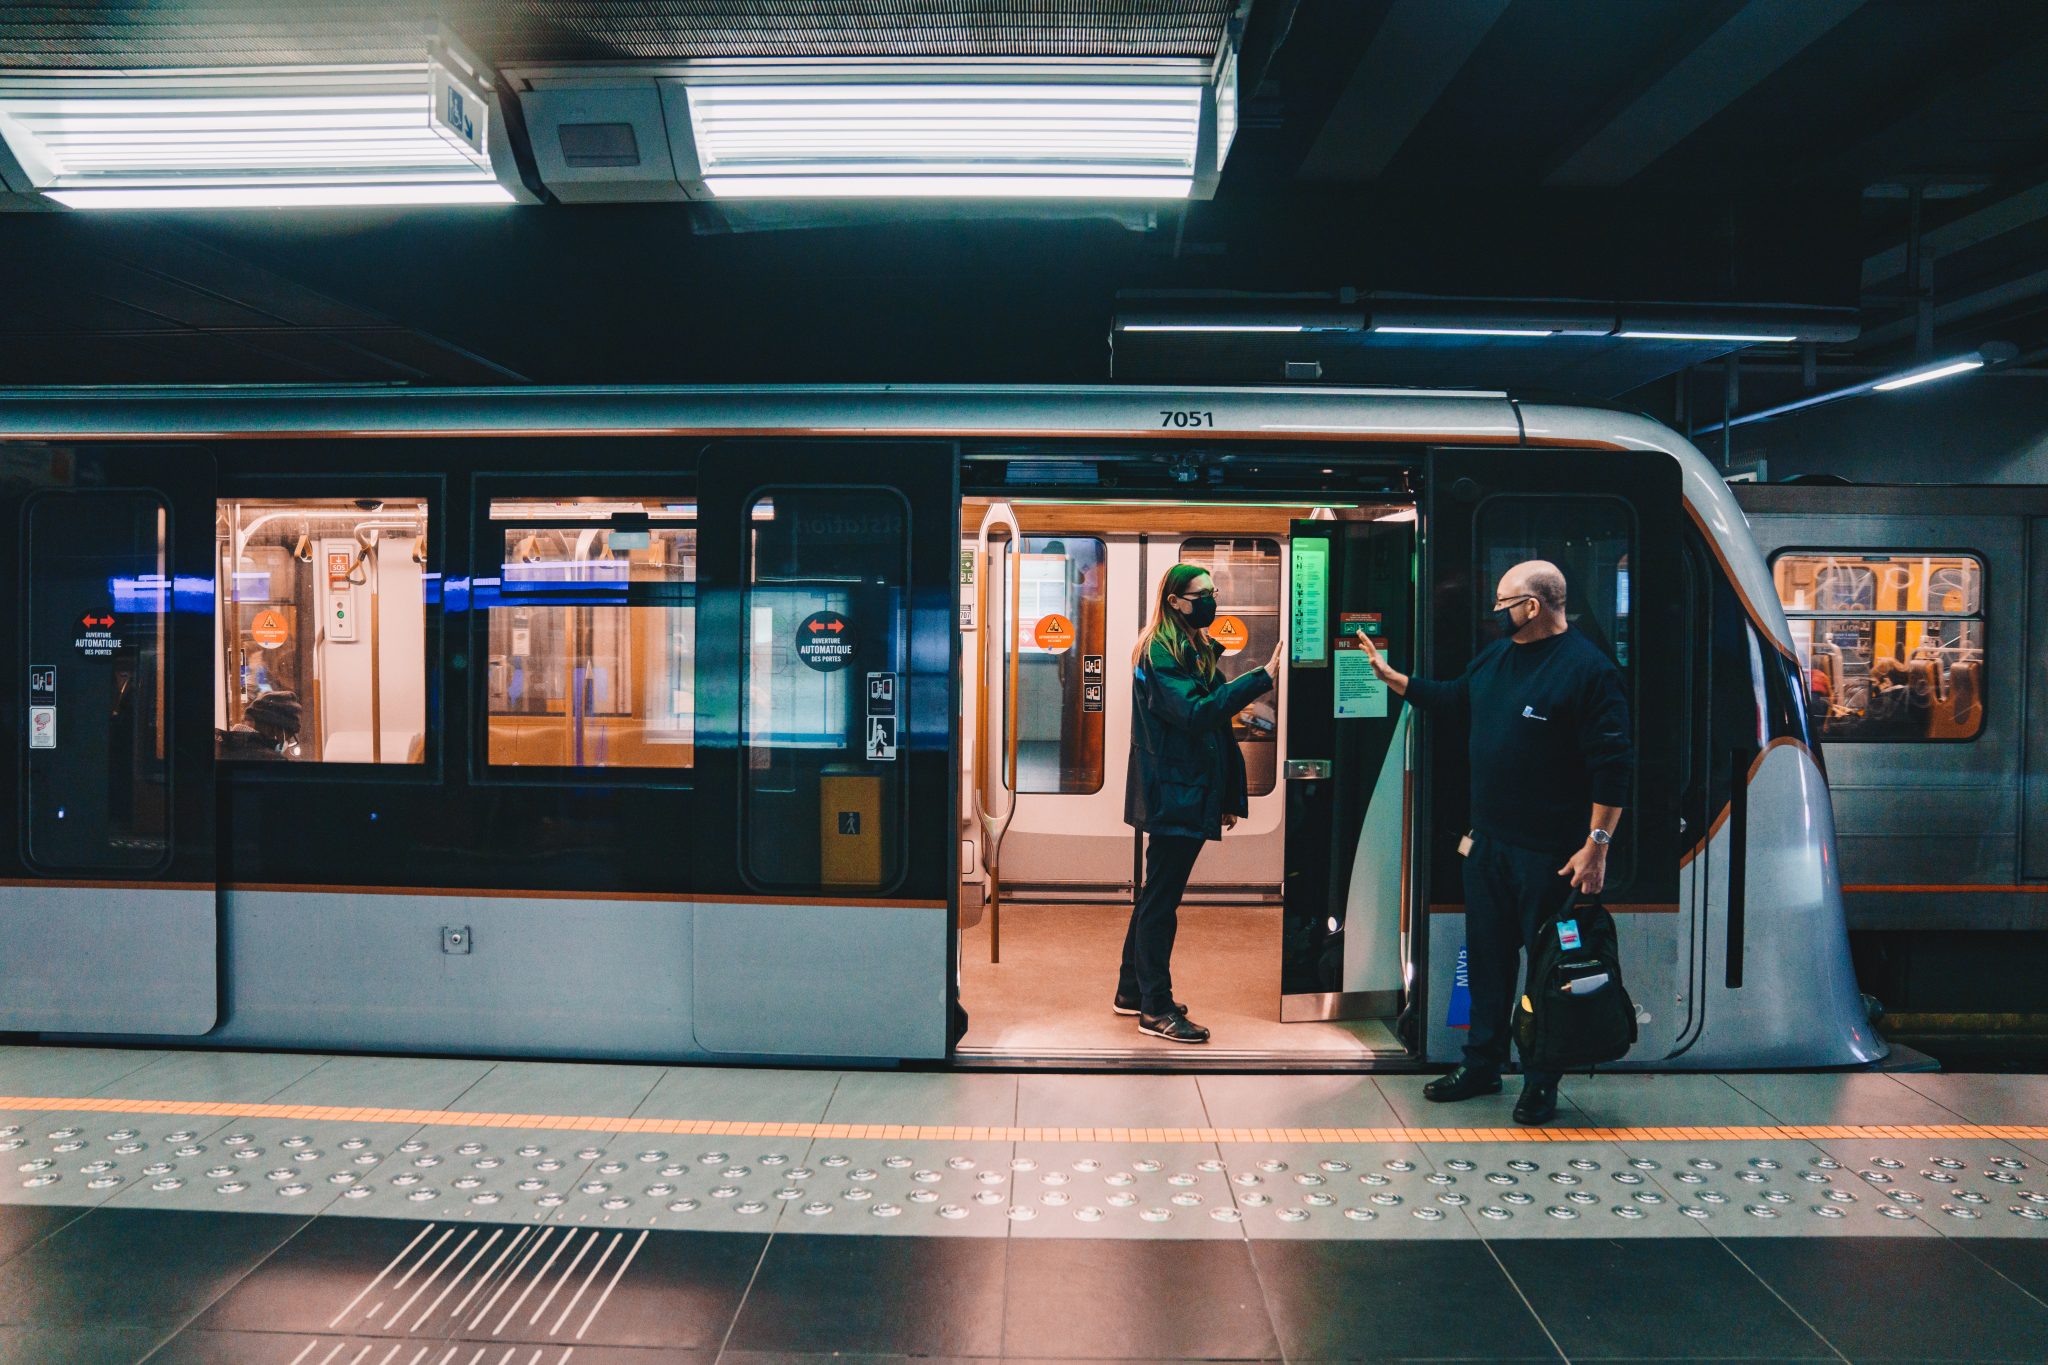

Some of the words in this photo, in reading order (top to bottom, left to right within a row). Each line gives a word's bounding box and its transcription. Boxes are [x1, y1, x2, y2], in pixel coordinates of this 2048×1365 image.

[1160, 411, 1213, 427] 7051
[75, 639, 122, 648] AUTOMATIQUE
[800, 645, 852, 654] AUTOMATIQUE
